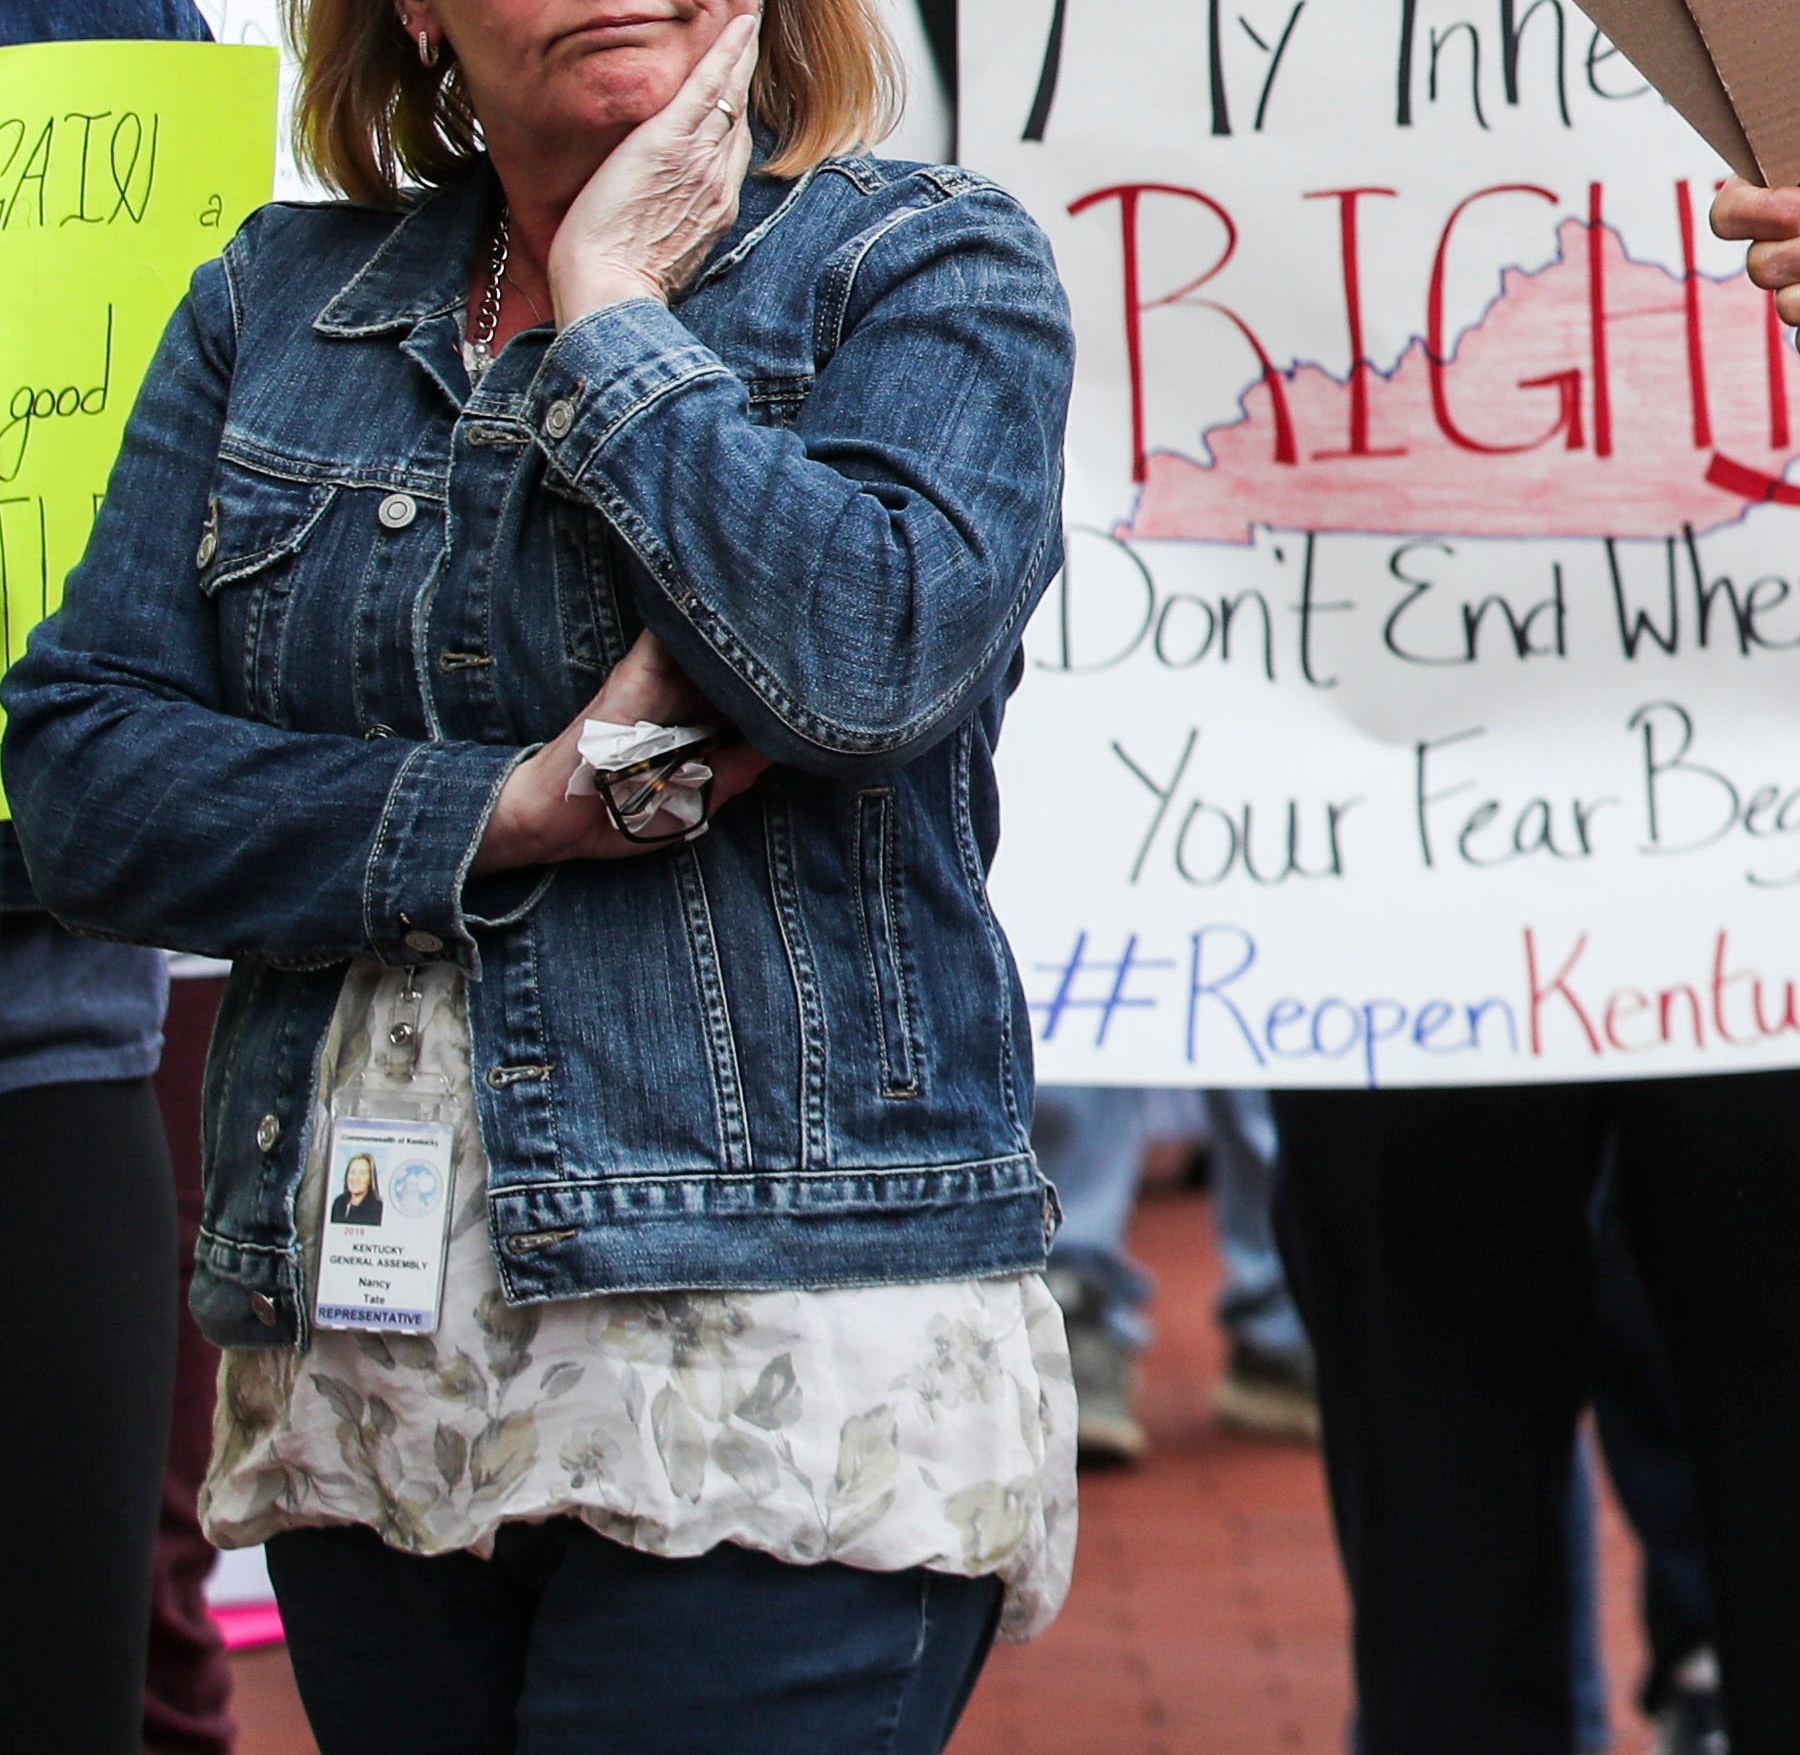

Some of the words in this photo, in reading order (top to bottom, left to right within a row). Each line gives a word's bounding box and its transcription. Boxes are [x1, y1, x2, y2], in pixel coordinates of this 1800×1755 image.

[0, 302, 112, 483] good
[1036, 524, 1355, 687] Don't
[1385, 541, 1566, 666] End
[1112, 726, 1368, 886] Your
[1415, 727, 1622, 870] Fear
[352, 1244, 404, 1256] KENTUCKY
[329, 1255, 373, 1267] GENERAL
[376, 1258, 428, 1270] ASSEMBLY
[358, 1277, 391, 1290] Nancy
[364, 1293, 385, 1305] Tate
[318, 1307, 423, 1325] REPRESENTATIVE
